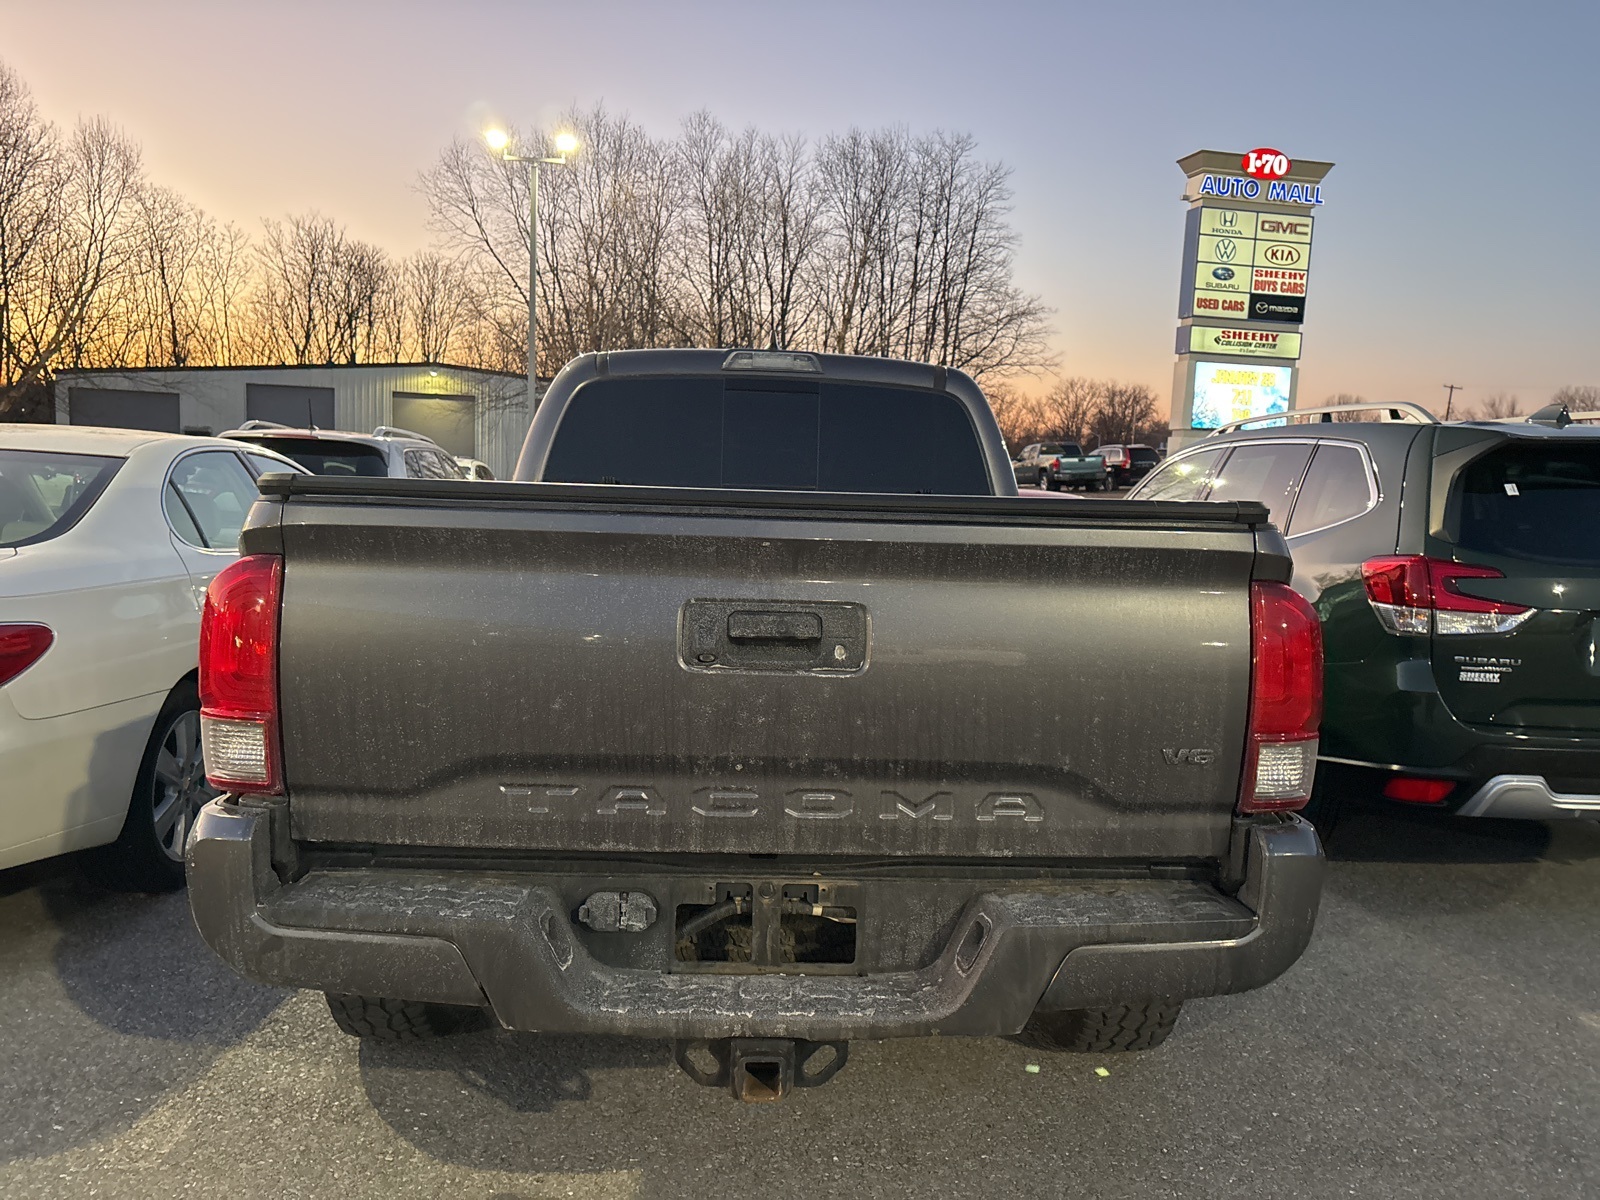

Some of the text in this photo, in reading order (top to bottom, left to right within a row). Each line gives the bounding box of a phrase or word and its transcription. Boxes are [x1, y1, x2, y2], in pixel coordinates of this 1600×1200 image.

[1200, 175, 1324, 205] AUTO MALL
[1211, 227, 1243, 236] HONDA
[1261, 220, 1309, 236] GMC
[1270, 249, 1295, 262] KIA
[1254, 269, 1306, 281] SHEEHY
[1205, 281, 1240, 290] SUBARU
[1253, 279, 1305, 295] BUYS CARS
[1196, 297, 1245, 312] USED CARS
[1268, 304, 1299, 314] mazda
[1221, 330, 1280, 342] SHEEHY
[1220, 340, 1254, 348] COLLISION
[1211, 369, 1260, 386] JANUARY
[1454, 655, 1522, 666] SUBARU
[1161, 748, 1215, 765] V6
[499, 783, 1045, 822] TACOMA
